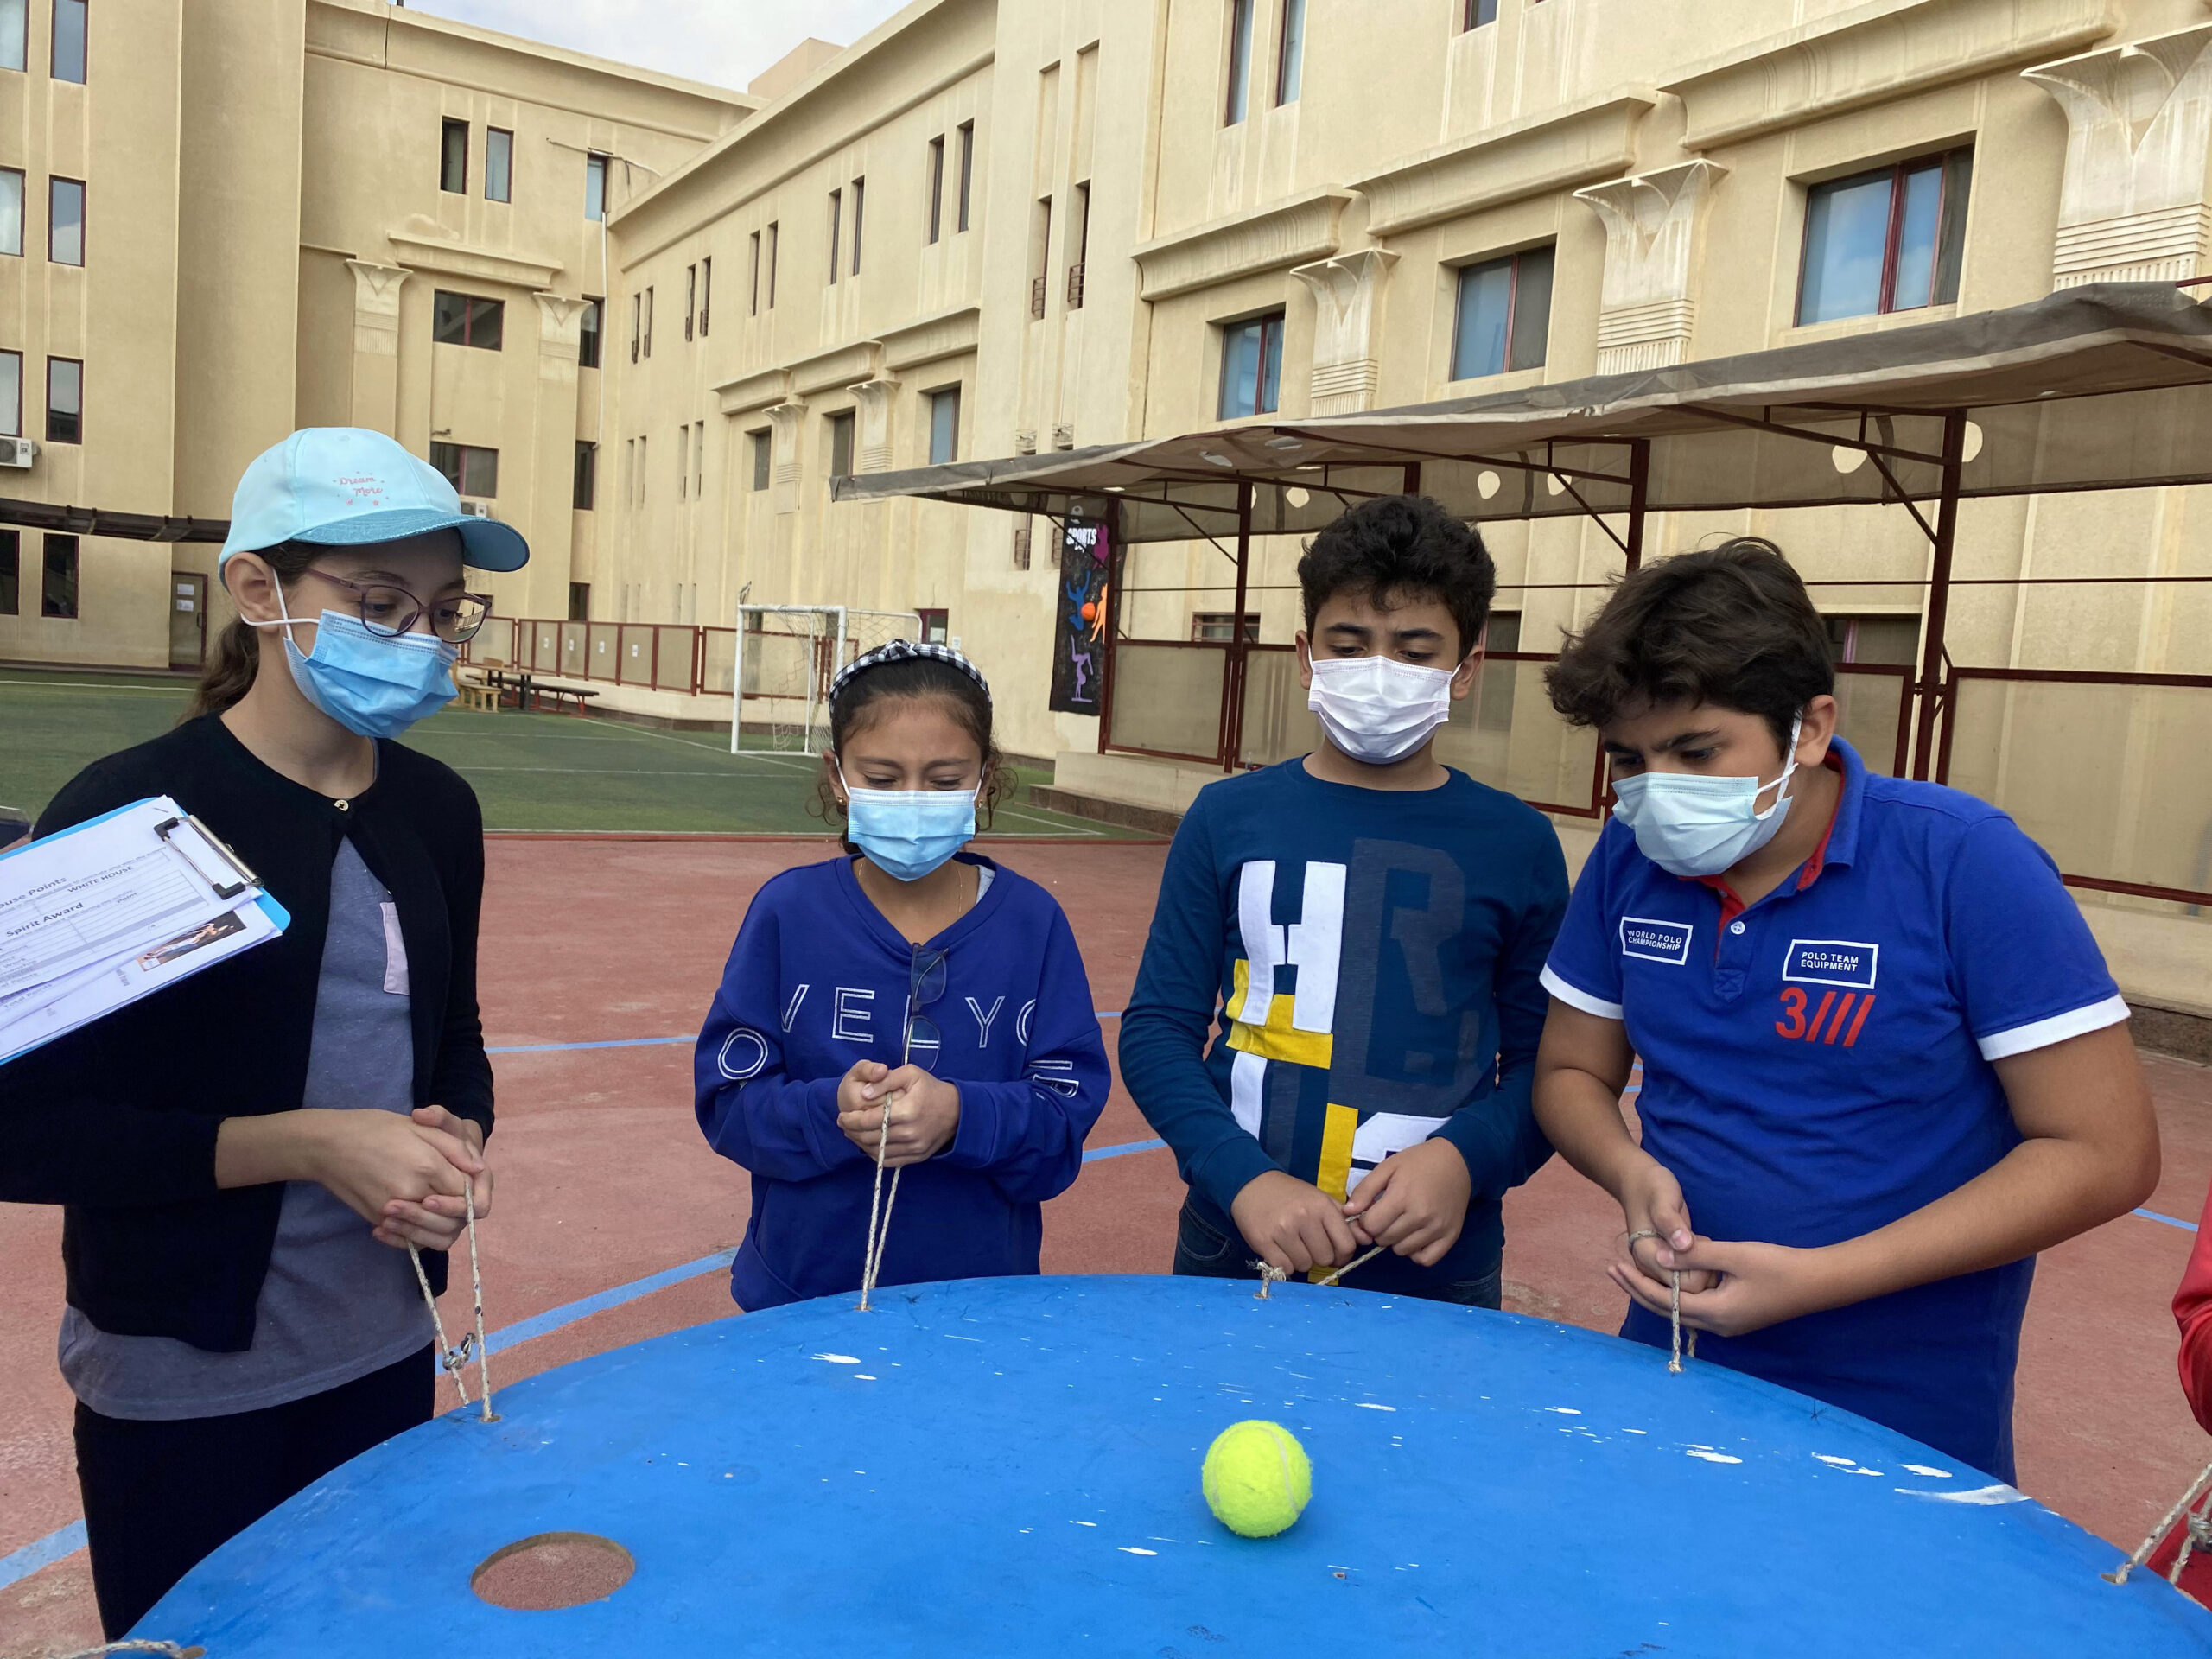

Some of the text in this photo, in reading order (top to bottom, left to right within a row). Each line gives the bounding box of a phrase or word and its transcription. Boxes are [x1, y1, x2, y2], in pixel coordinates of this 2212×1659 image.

[340, 477, 376, 486] Dream
[353, 486, 383, 497] More
[1066, 527, 1097, 546] SPORTS
[28, 877, 67, 896] Points
[67, 866, 133, 893] WHITE HOUSE
[6, 902, 84, 938] Spirit Award
[1627, 930, 1682, 944] WORLD POLO
[1628, 936, 1681, 951] CHAMPIONSHIP
[1802, 951, 1859, 964] POLO TEAM
[1801, 959, 1858, 972] EQUIPMENT
